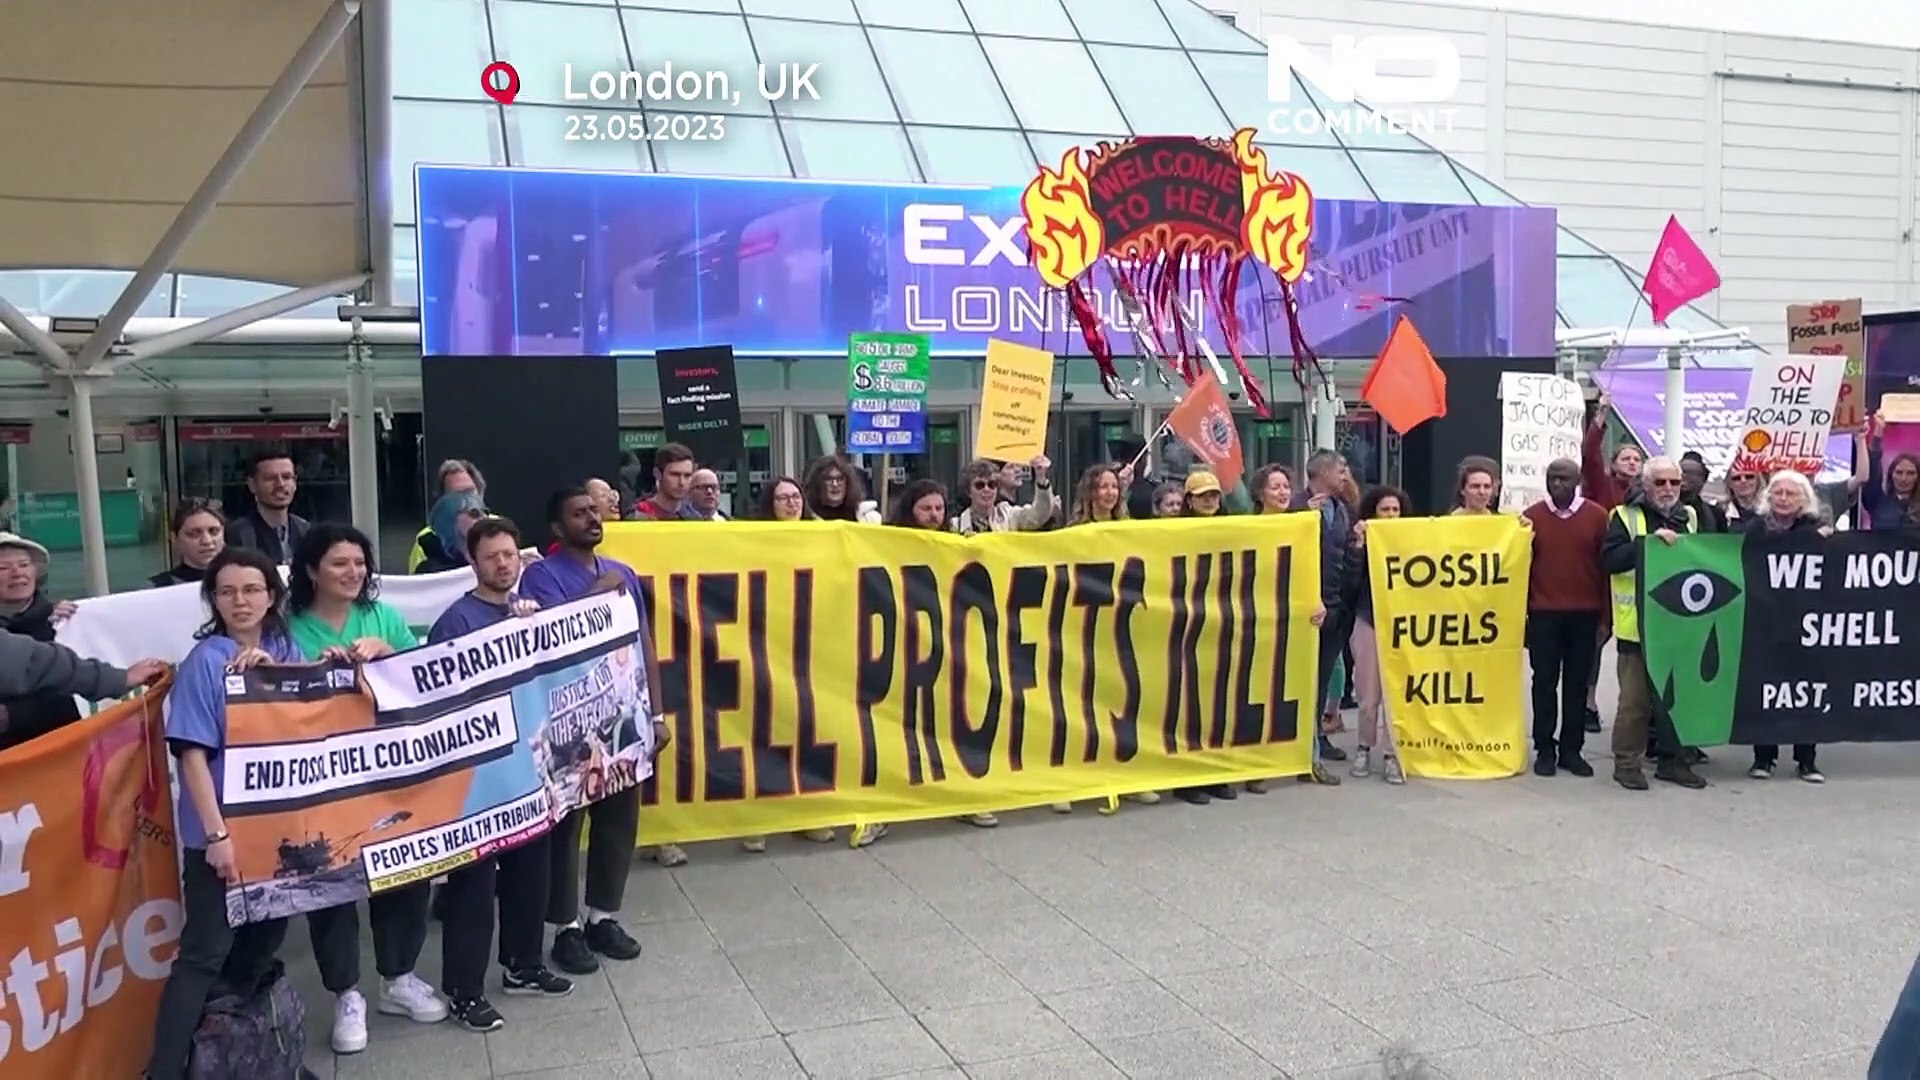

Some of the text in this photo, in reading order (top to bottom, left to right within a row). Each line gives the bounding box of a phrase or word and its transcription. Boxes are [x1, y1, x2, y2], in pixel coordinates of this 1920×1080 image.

[1091, 150, 1242, 201] WELCOME
[1107, 185, 1240, 238] TO HELL
[1341, 227, 1426, 283] PURSUIT
[1429, 212, 1471, 246] UNIT
[1808, 304, 1841, 322] STOP
[1790, 325, 1829, 342] FOSSIL
[991, 365, 1009, 375] Dear
[1778, 364, 1815, 384] ON
[1518, 376, 1575, 400] STOP
[1770, 387, 1811, 405] THE
[704, 420, 728, 428] DELTA
[1745, 407, 1801, 426] ROAD
[1809, 409, 1831, 426] TO
[625, 433, 658, 442] ENTRY
[1511, 433, 1539, 452] GAS
[1772, 431, 1822, 459] HELL
[1386, 553, 1509, 590] FOSSIL
[1767, 551, 1920, 589] WE MOU
[1392, 611, 1499, 649] FUELS
[1801, 610, 1900, 647] SHELL
[412, 603, 613, 694] REPARATIVE JUSTICE NOW
[640, 545, 1299, 806] HELL PROFITS KILL
[1405, 671, 1484, 706] KILL
[1762, 679, 1920, 713] PAST, PRES
[244, 761, 284, 791] END
[329, 746, 371, 778] FUEL
[374, 711, 501, 769] COLONIALISM
[370, 835, 439, 872] PEOPLES'
[443, 816, 491, 852] HEALTH
